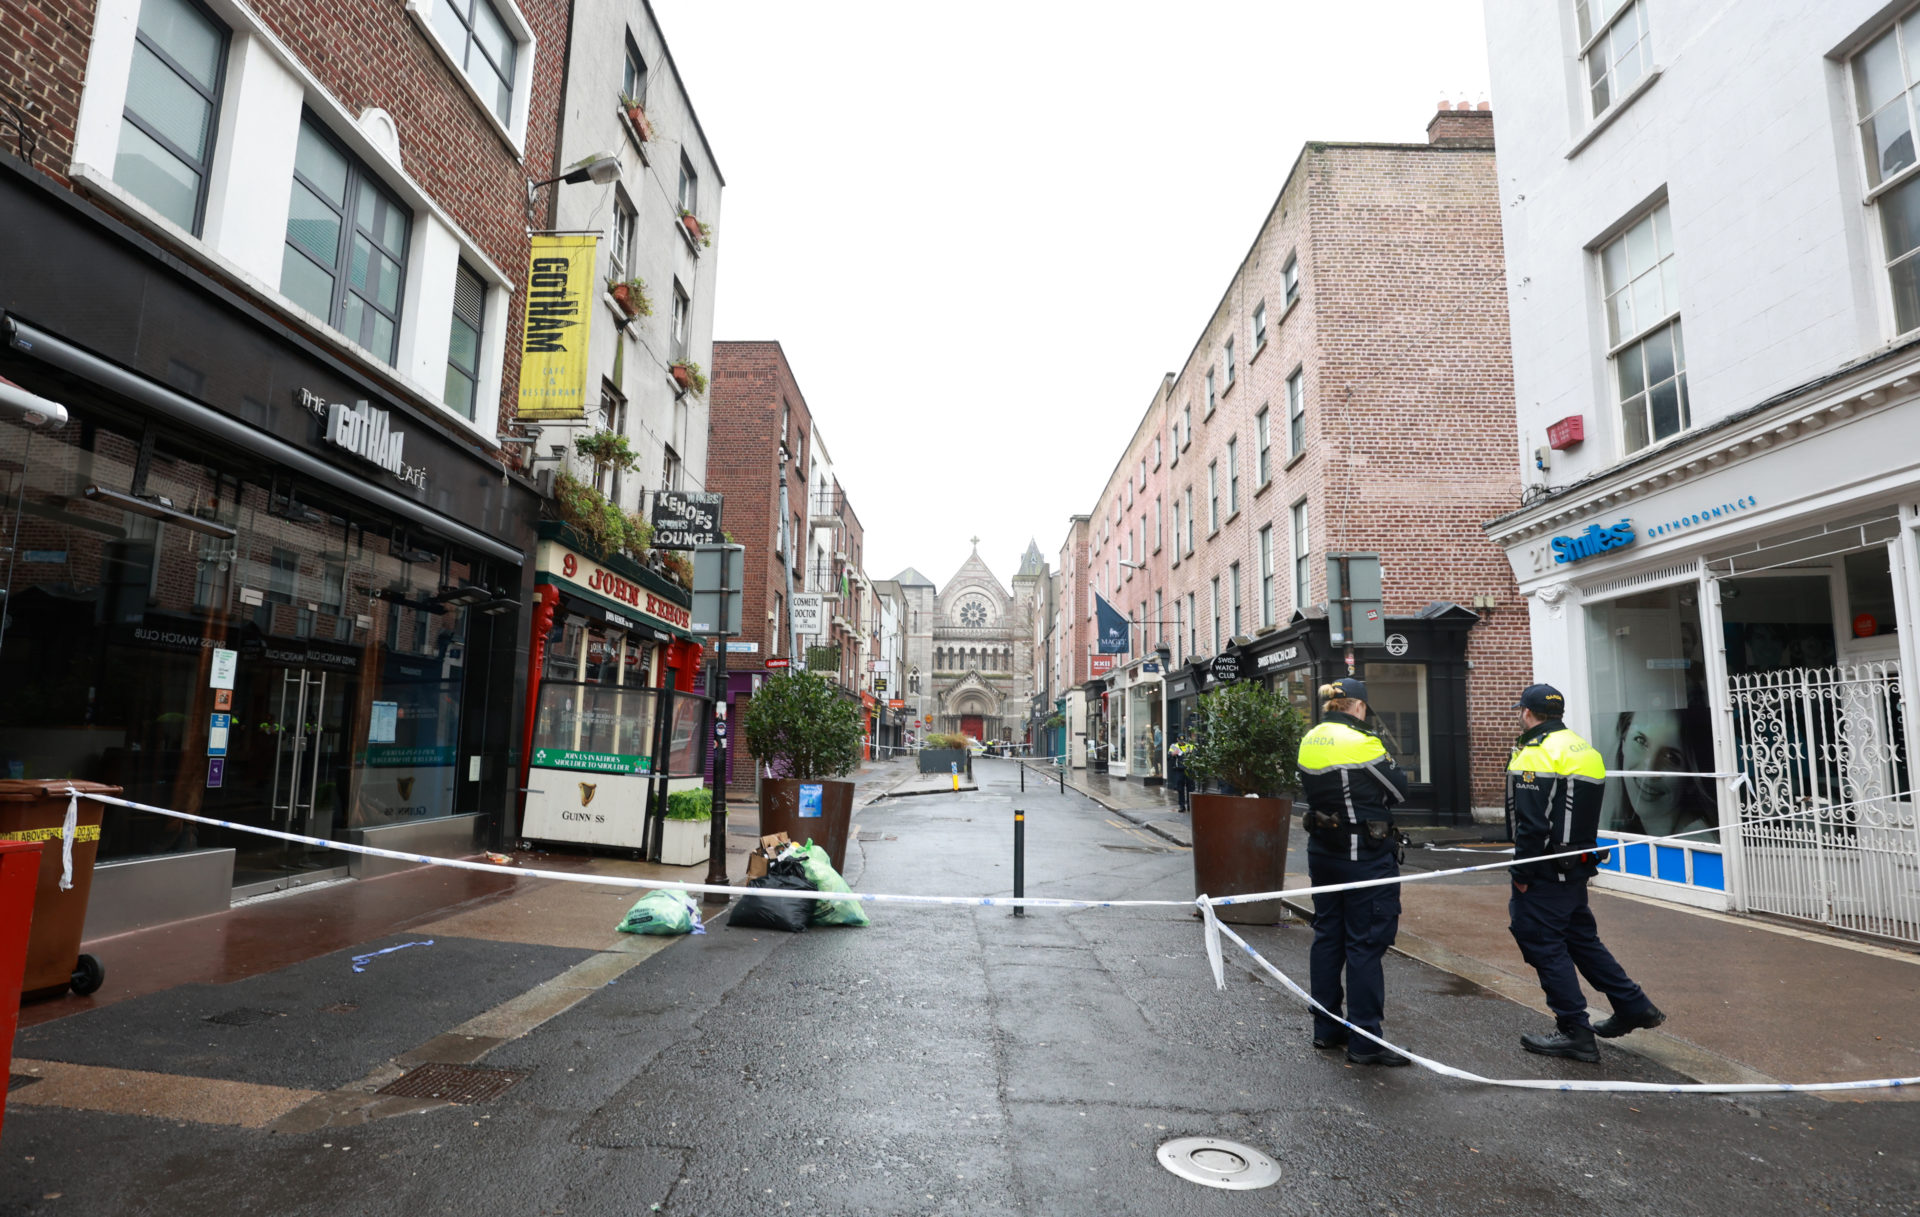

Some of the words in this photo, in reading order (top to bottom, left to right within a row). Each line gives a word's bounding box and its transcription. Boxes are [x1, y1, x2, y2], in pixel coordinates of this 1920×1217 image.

[525, 257, 583, 352] GOTHAM
[522, 388, 583, 397] RESTAURANT
[301, 387, 326, 416] THE
[327, 400, 405, 476] GOTHAM
[396, 461, 427, 490] CAFÉ
[659, 492, 713, 530] KEHOES
[1551, 518, 1637, 564] Smiles
[1648, 495, 1757, 538] ORTHODONTICS
[653, 531, 713, 545] LOUNGE
[563, 553, 578, 578] 9
[588, 568, 640, 606] JOHN
[646, 593, 690, 629] KEHOE
[793, 598, 818, 606] COSMETIC
[795, 609, 816, 618] DOCTOR
[1257, 656, 1270, 668] SWISS
[1269, 650, 1285, 664] WATCH
[1284, 646, 1297, 660] CLUB
[564, 752, 579, 760] JOIN
[554, 759, 587, 768] SHOULDER
[588, 761, 597, 769] TO
[597, 762, 630, 771] SHOULDER
[1516, 783, 1540, 791] GARDA
[562, 811, 605, 823] GUINNSS
[21, 829, 45, 841] ABOVE
